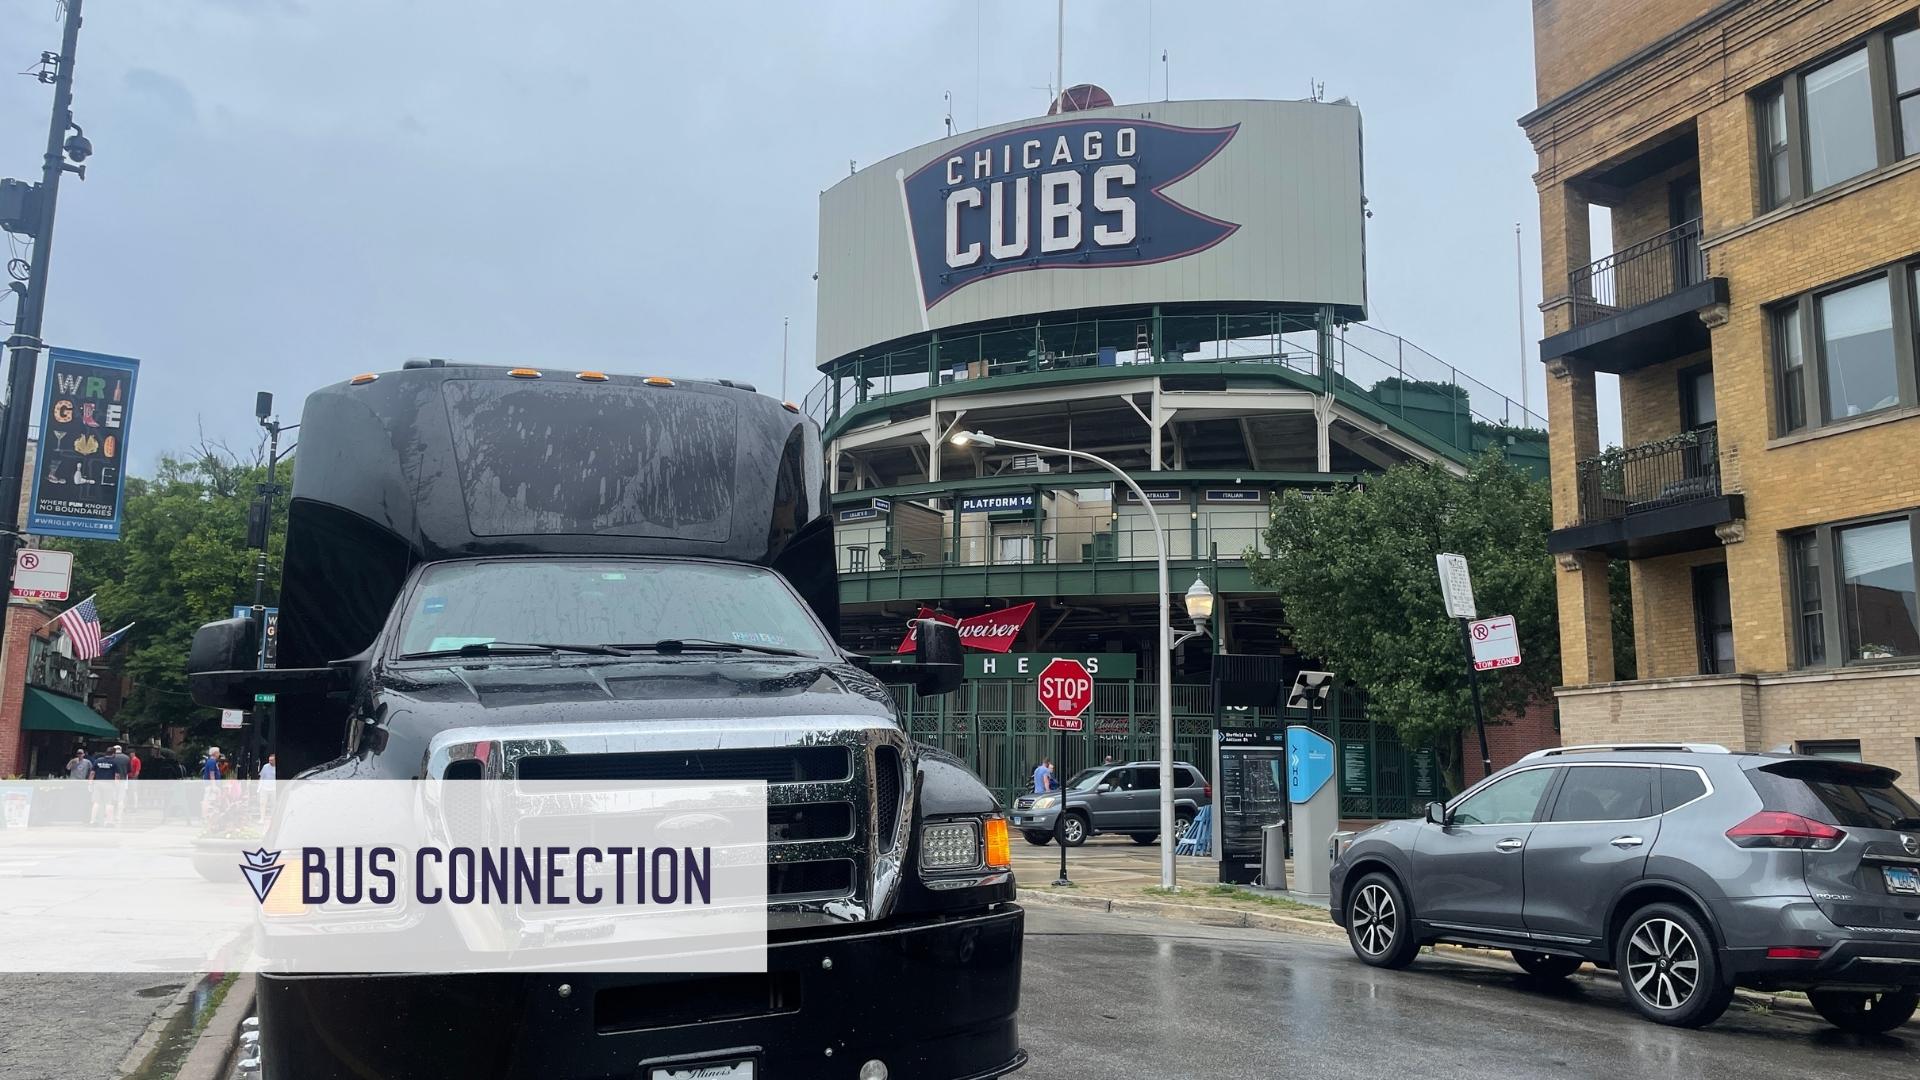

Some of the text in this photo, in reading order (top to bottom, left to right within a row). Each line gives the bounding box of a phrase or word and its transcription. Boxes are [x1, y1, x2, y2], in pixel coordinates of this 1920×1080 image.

[947, 127, 1136, 185] CHICAGO
[946, 164, 1136, 268] CUBS
[40, 499, 67, 508] WHERE
[85, 503, 112, 511] KNOWS
[963, 496, 1032, 509] PLATFORM 14
[55, 506, 112, 517] BOUNDARIES
[35, 518, 113, 530] #WRIGLEYVILLE365
[18, 589, 62, 599] TOW ZONE
[1477, 657, 1516, 669] TOW ZONE
[1043, 677, 1089, 699] STOP
[1052, 719, 1079, 728] ALL WAY
[690, 1069, 732, 1079] Illinois
